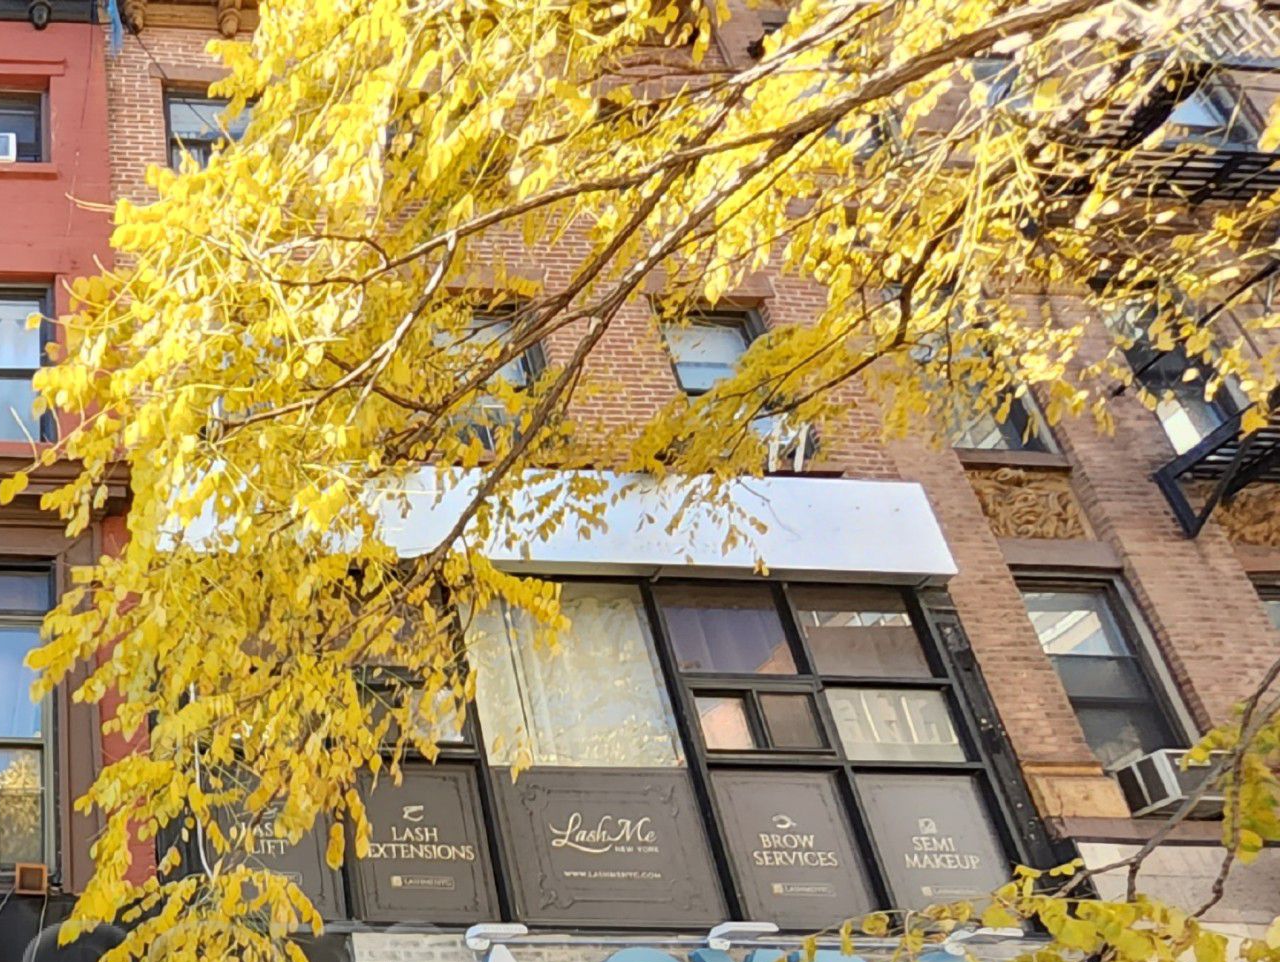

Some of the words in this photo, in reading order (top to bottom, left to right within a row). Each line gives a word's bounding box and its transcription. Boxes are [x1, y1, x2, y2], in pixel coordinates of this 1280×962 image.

[391, 826, 439, 843] LASH
[759, 833, 815, 849] BROW
[366, 842, 475, 861] EXTENSIONS
[911, 836, 956, 853] SEMI
[752, 851, 838, 867] SERVICES
[904, 853, 981, 870] MAKEUP
